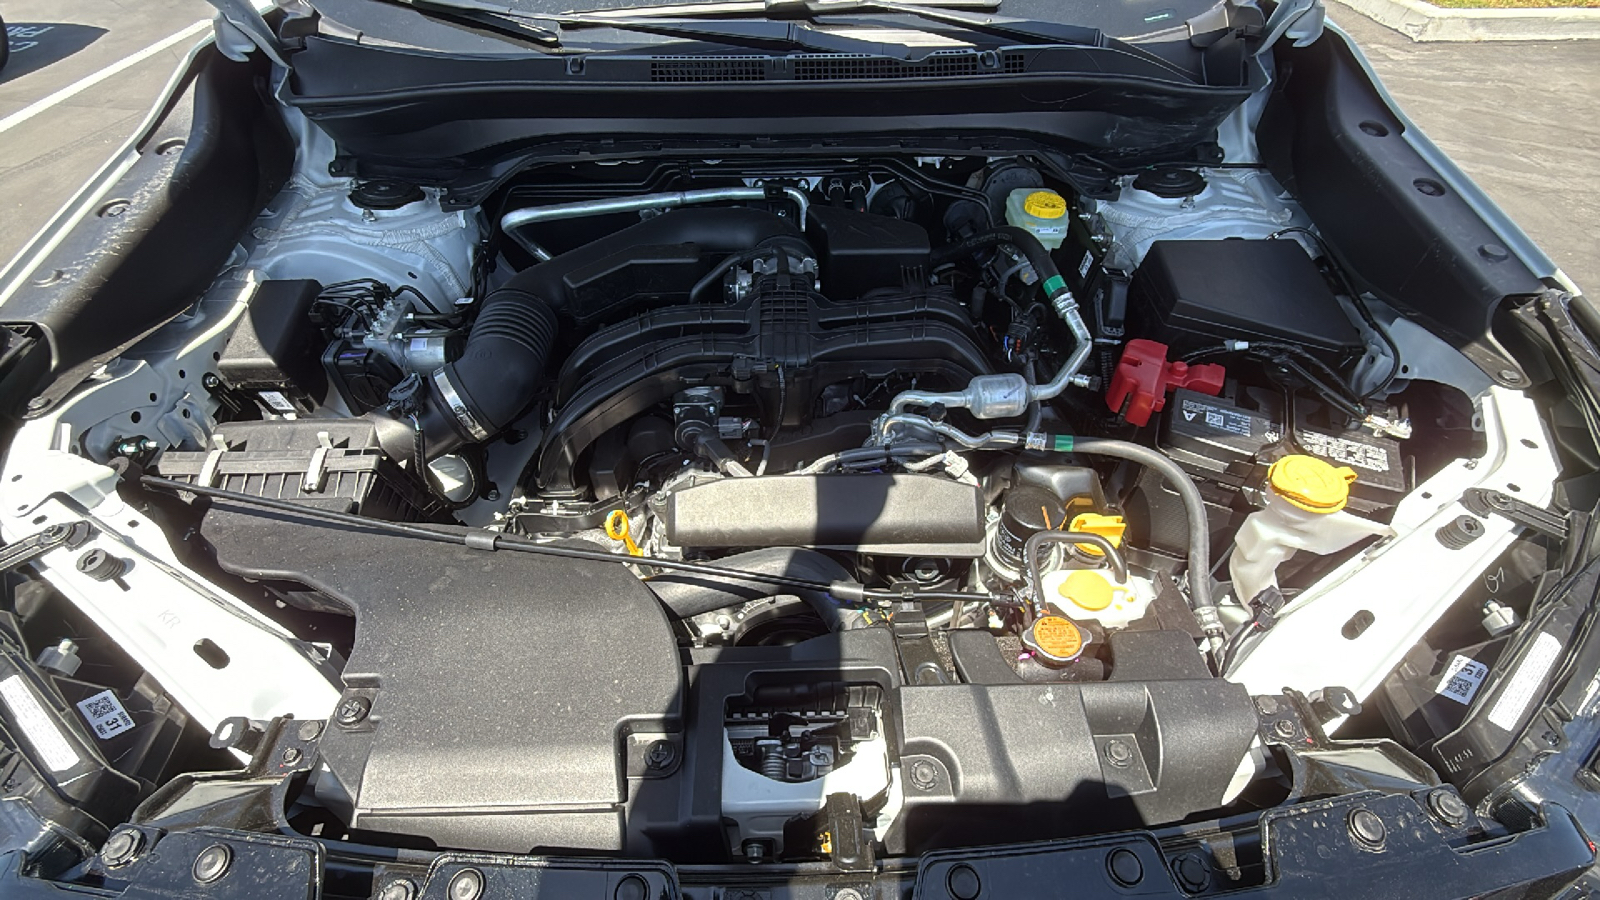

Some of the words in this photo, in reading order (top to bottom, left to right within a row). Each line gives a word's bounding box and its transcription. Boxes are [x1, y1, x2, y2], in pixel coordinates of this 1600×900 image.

[157, 609, 181, 629] KR
[1461, 663, 1477, 675] 31
[105, 717, 122, 731] 31
